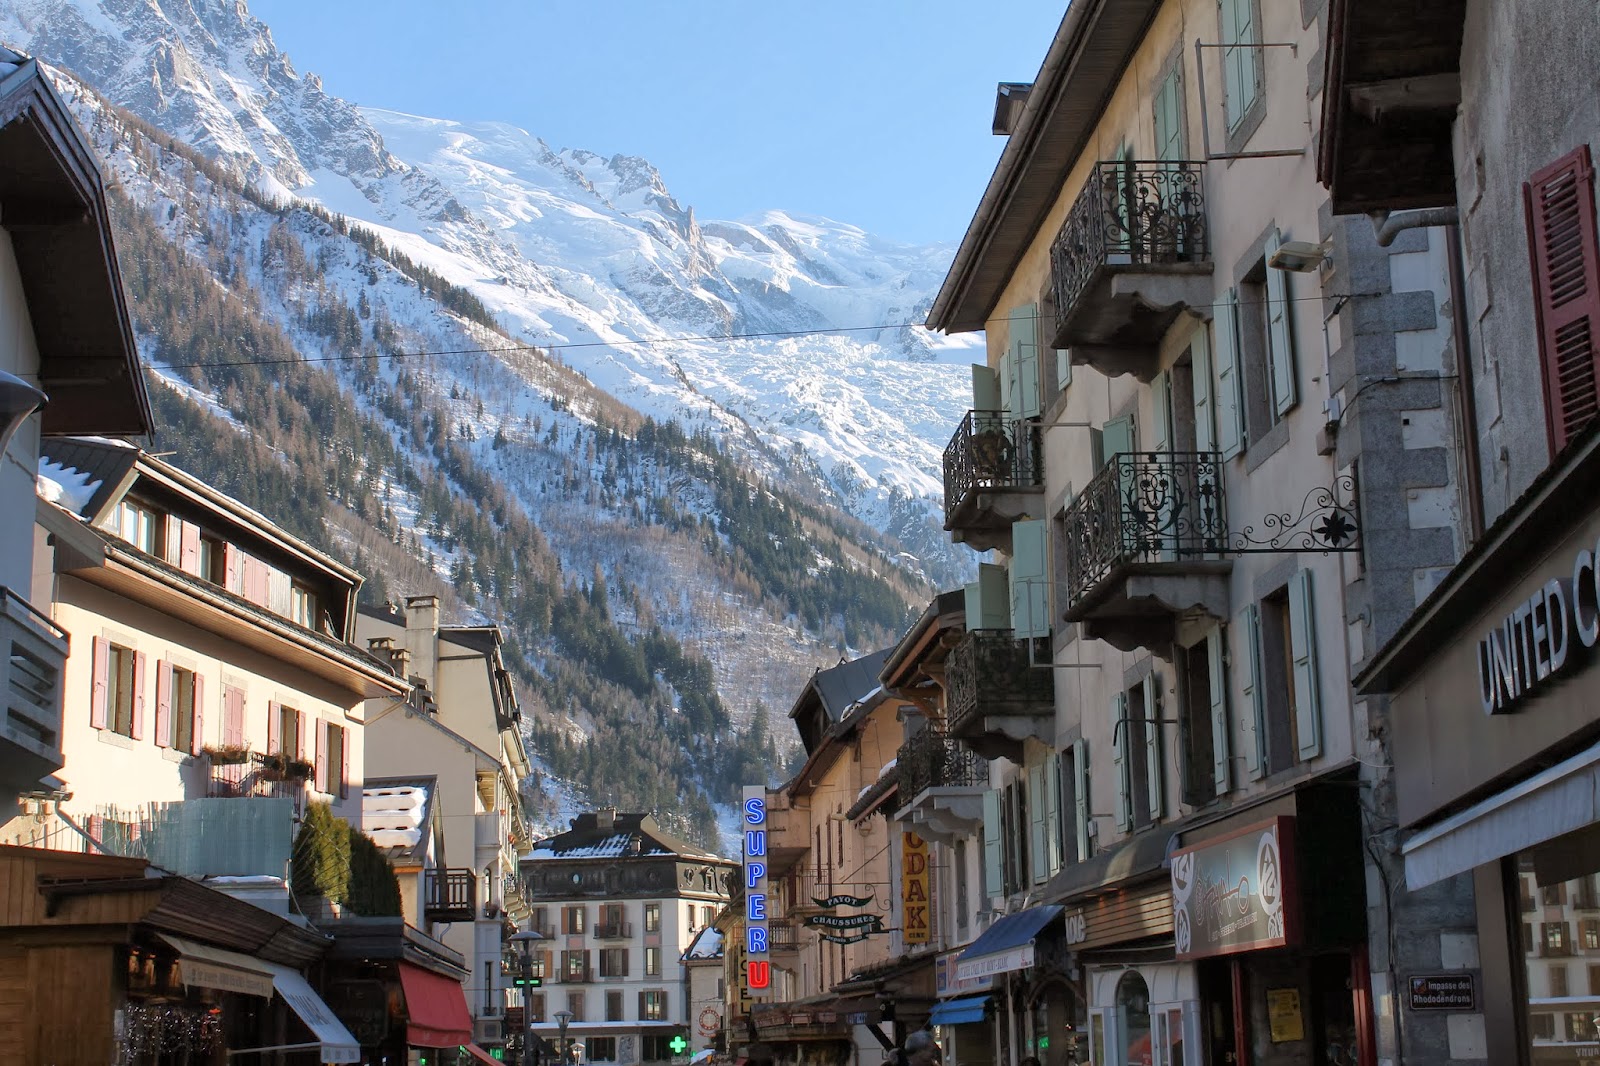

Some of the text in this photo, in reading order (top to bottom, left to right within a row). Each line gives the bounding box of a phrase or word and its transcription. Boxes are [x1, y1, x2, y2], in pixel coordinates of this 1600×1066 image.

[1477, 536, 1600, 716] UNITED C
[745, 797, 770, 989] SUPER U
[827, 895, 858, 906] PAYOT
[812, 915, 875, 926] CHAUSSURES
[1428, 980, 1470, 990] Impasse des
[1413, 994, 1470, 1003] Rhododendrons
